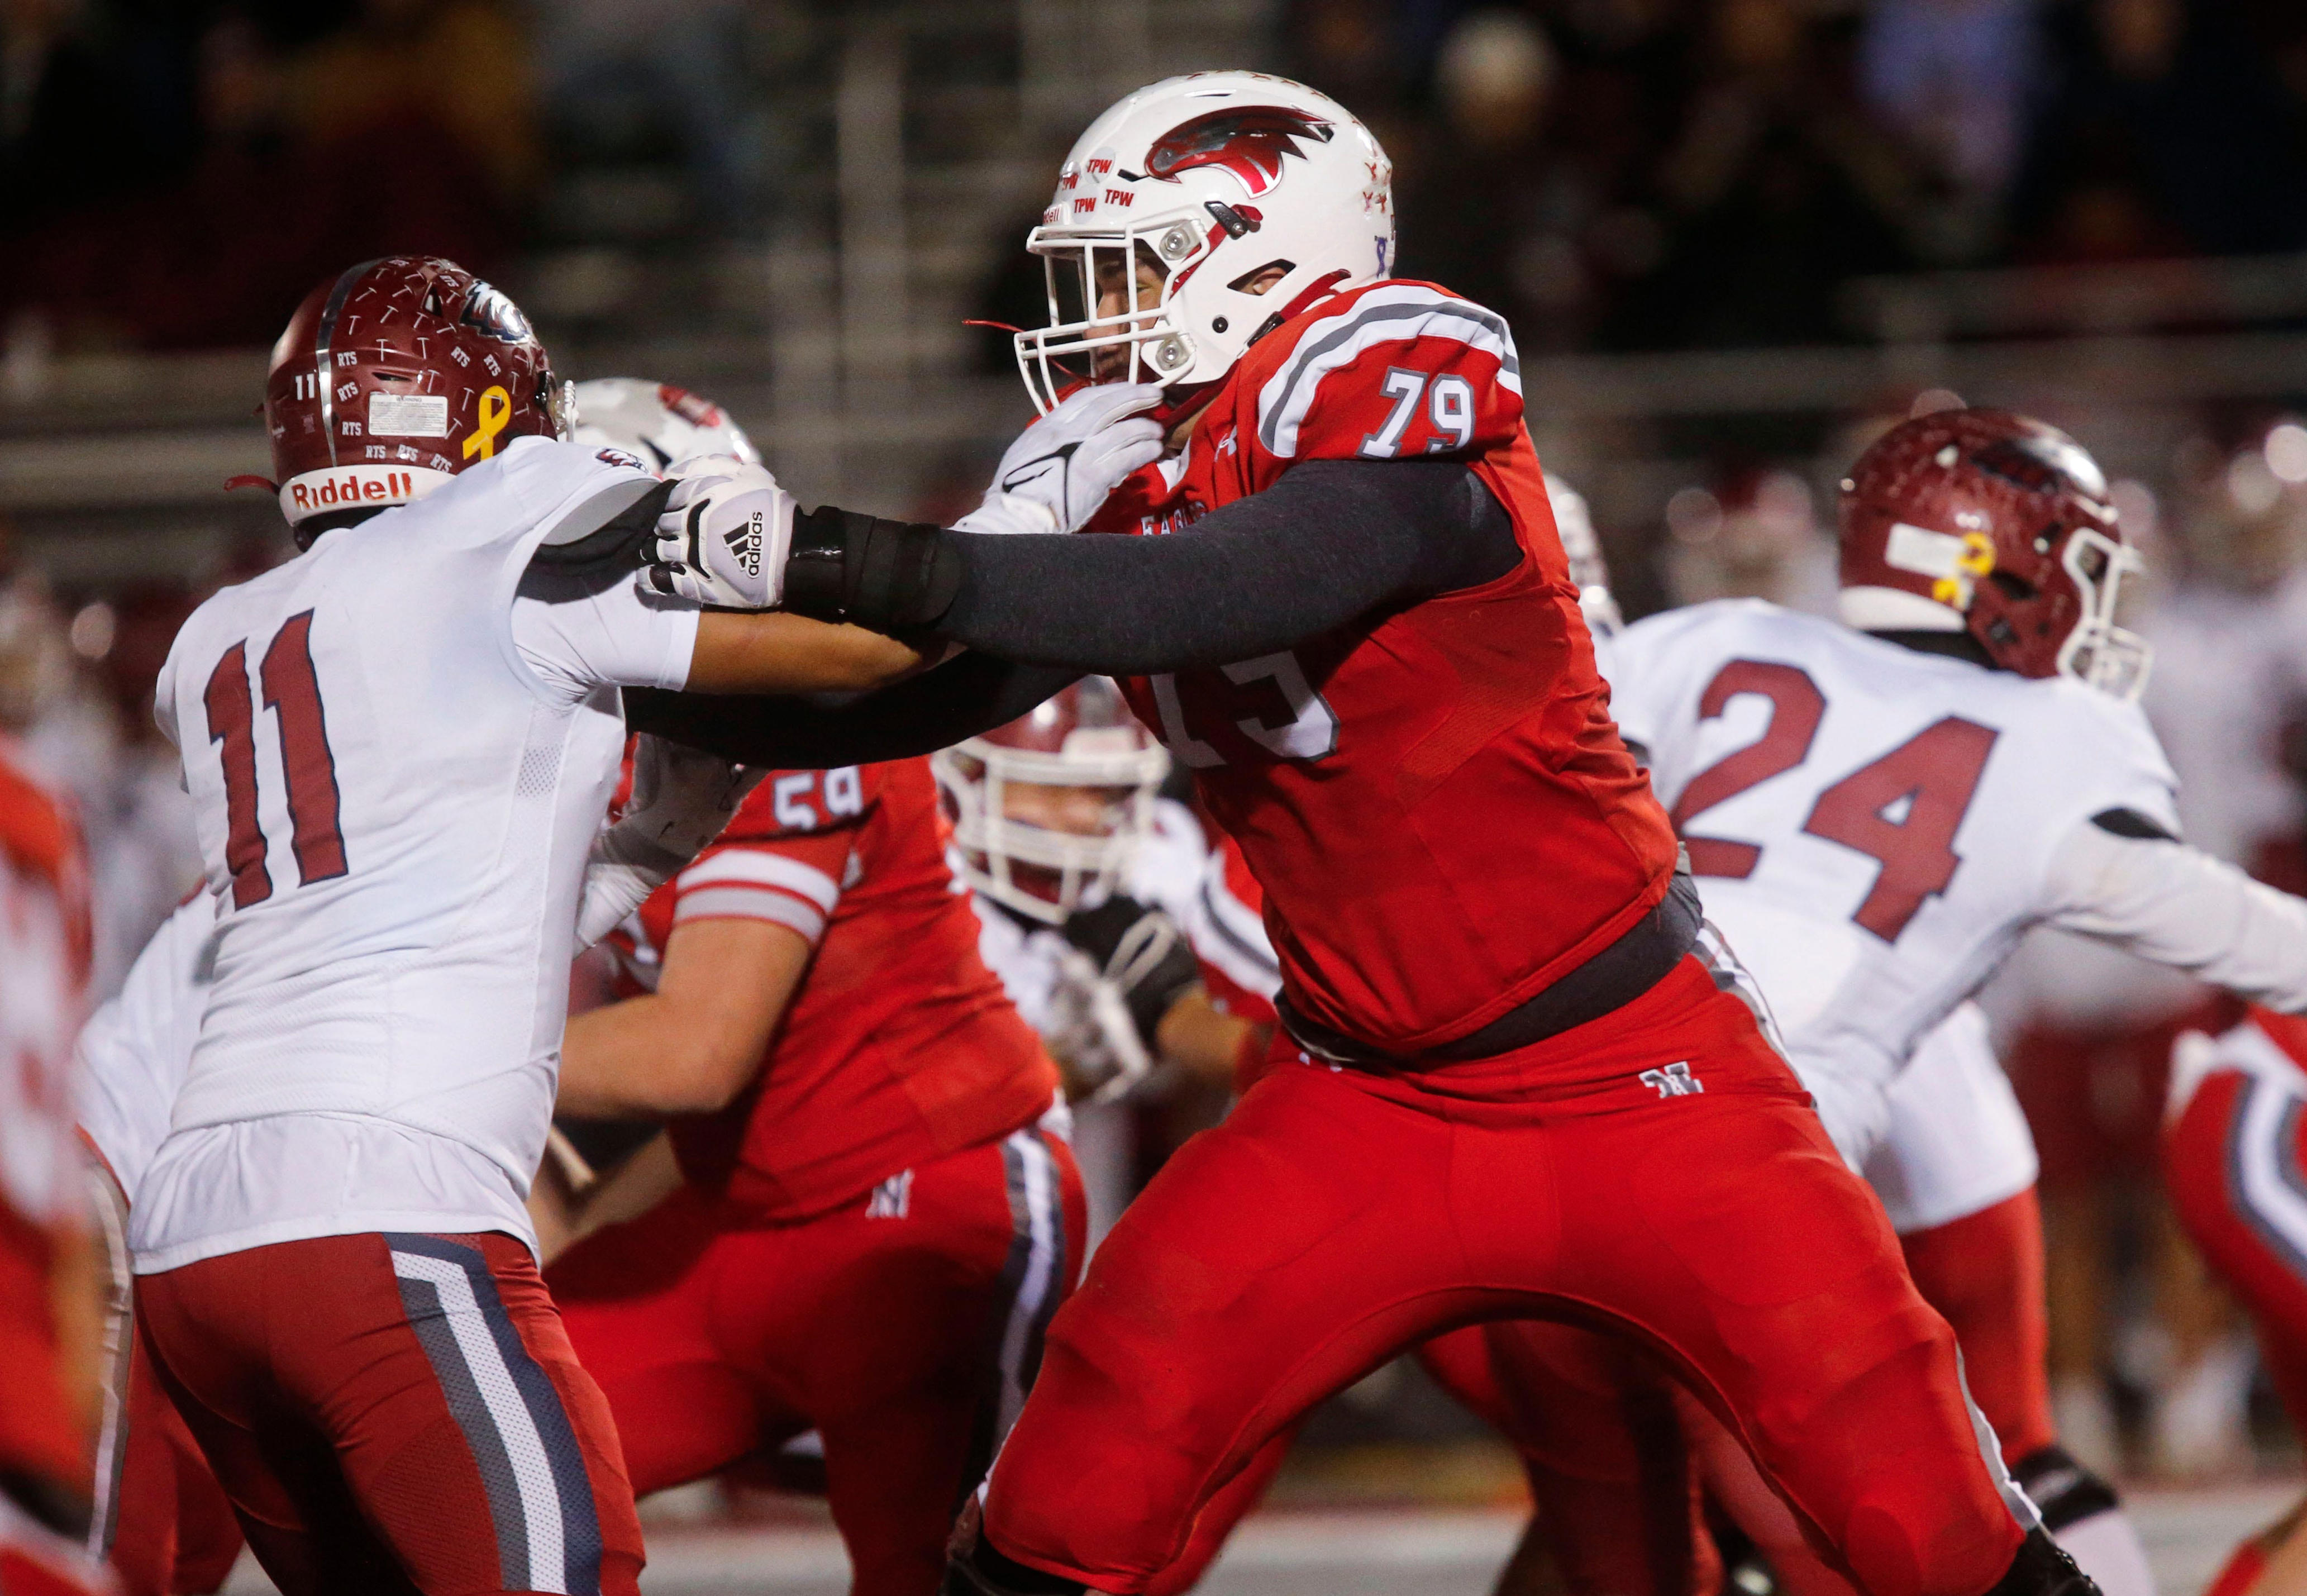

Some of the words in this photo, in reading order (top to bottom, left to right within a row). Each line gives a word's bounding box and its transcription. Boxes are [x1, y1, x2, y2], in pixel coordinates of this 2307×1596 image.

[1087, 159, 1113, 174] TPW
[1075, 197, 1097, 213] TPW
[1105, 189, 1135, 207] TPW
[337, 350, 358, 367] RTS
[451, 346, 471, 368] RTS
[483, 354, 502, 377] RTS
[295, 373, 315, 401] 11
[337, 381, 359, 402] RTS
[1355, 366, 1476, 459] 79
[342, 421, 362, 436] RTS
[365, 445, 387, 459] RTS
[395, 444, 419, 462] RTS
[430, 453, 452, 473] RTS
[291, 473, 413, 509] Riddell
[747, 511, 762, 576] adidas
[203, 608, 349, 912] 11
[774, 766, 864, 832] 59
[1672, 658, 2001, 944] 24
